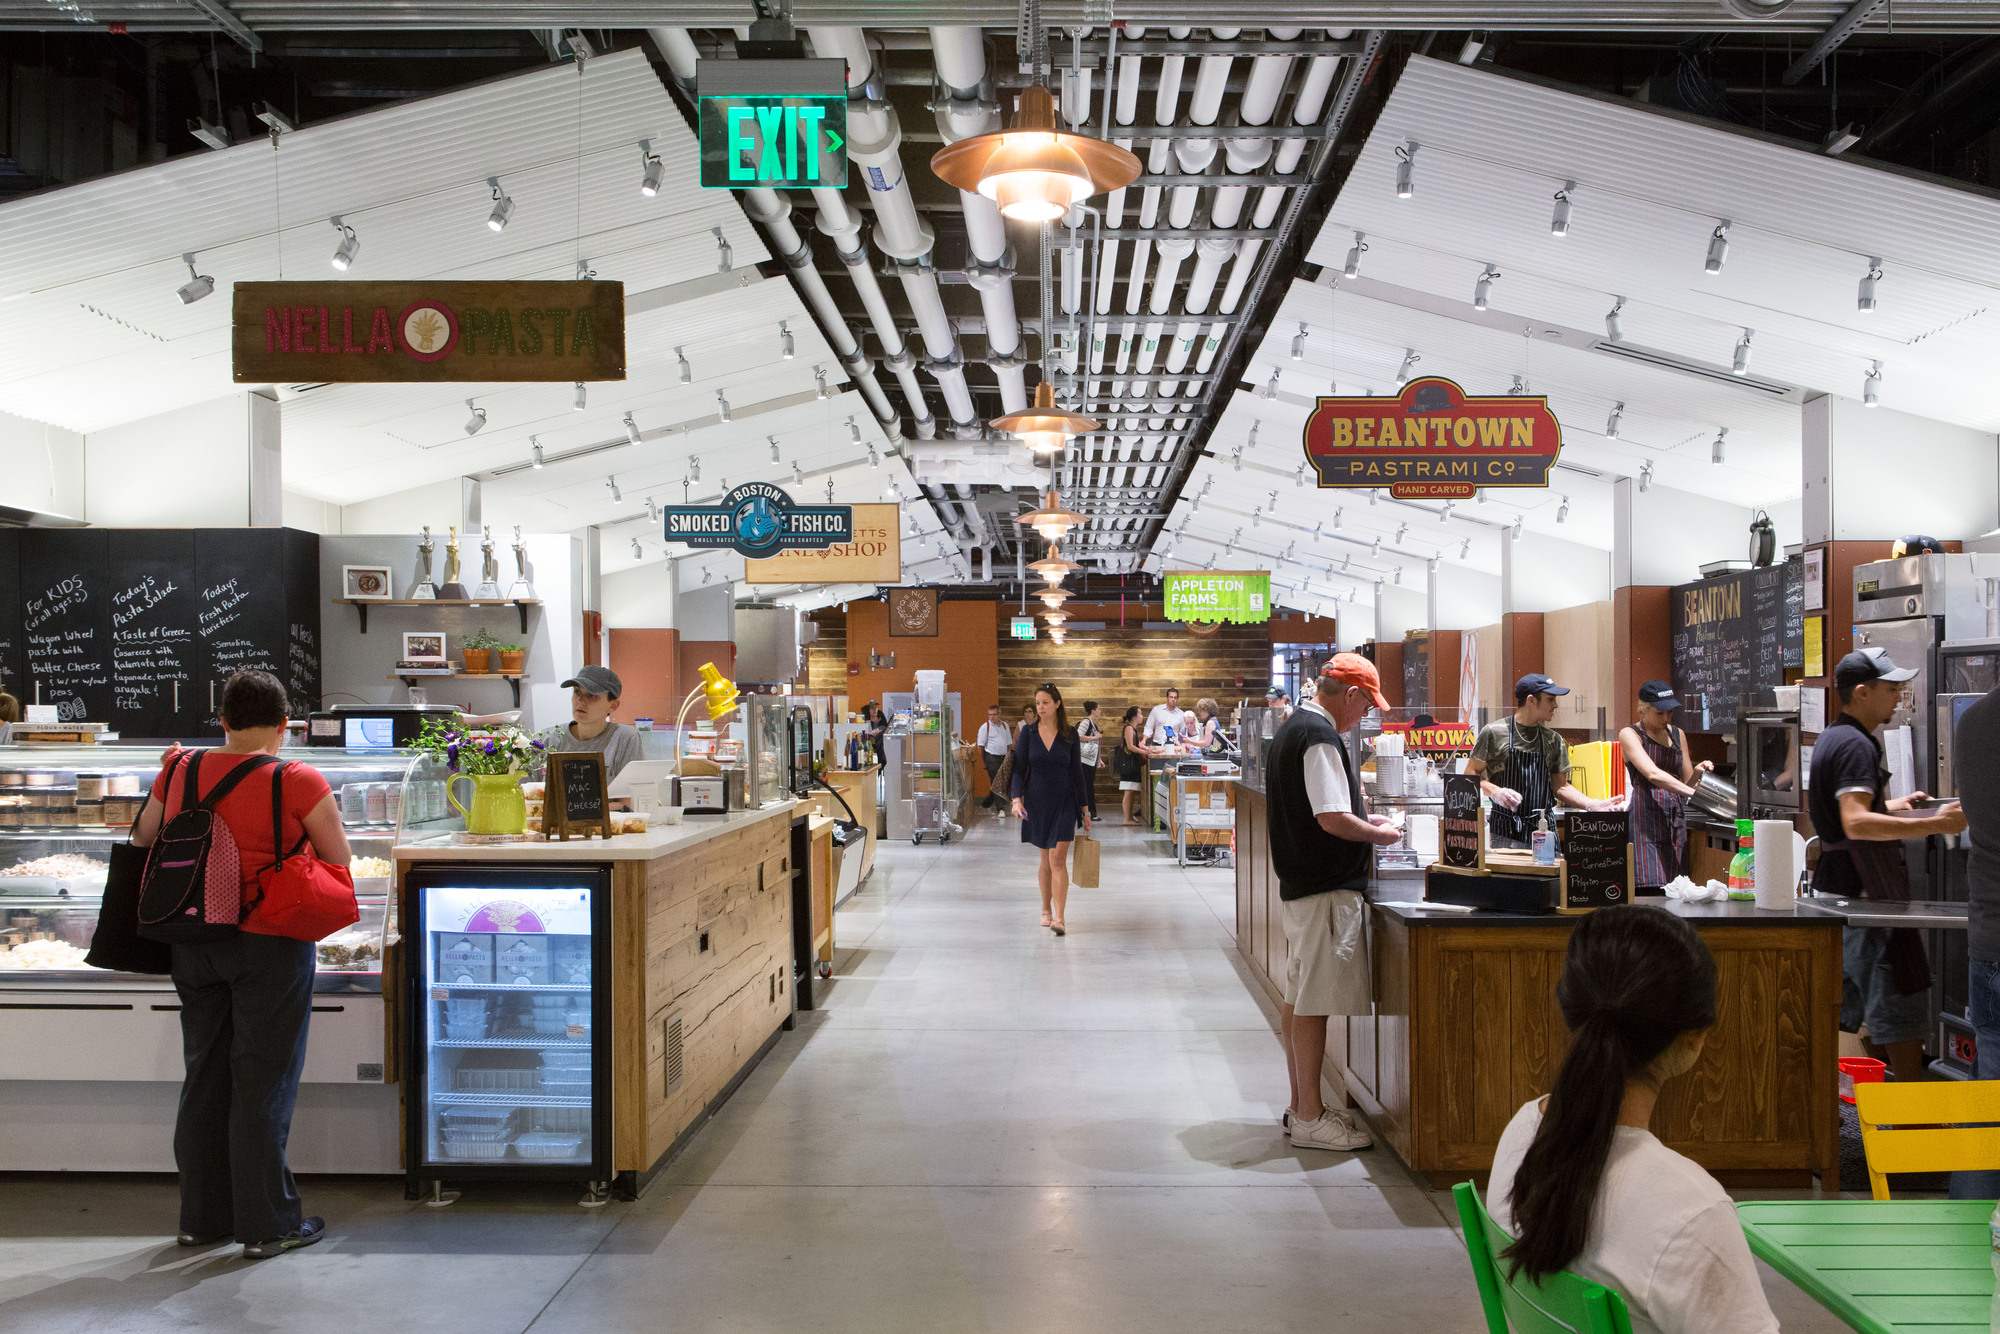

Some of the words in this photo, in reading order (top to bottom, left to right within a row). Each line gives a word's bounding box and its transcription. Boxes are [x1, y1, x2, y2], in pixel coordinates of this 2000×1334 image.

[728, 106, 825, 181] EXIT
[265, 306, 394, 354] NELLA
[462, 306, 597, 357] PASTA
[1331, 417, 1535, 448] BEANTOWN
[1350, 461, 1477, 476] PASTRAMI
[733, 484, 782, 502] BOSTON
[1397, 485, 1427, 495] HAND
[1430, 485, 1470, 495] CARVED
[670, 514, 730, 532] SMOKED
[791, 514, 822, 532] FISH
[824, 514, 847, 532] CO.
[833, 542, 887, 557] SHOP
[113, 575, 155, 606] Today's
[202, 577, 238, 601] Today's
[1171, 580, 1245, 592] APPLETON
[26, 598, 43, 615] For
[46, 574, 83, 601] KIDS
[1171, 593, 1219, 605] FARMS
[40, 608, 52, 621] all
[53, 596, 73, 614] ages
[113, 604, 145, 628] Pasta
[144, 581, 178, 608] Salad
[199, 606, 223, 624] Fresh
[221, 591, 250, 610] Pasta
[1684, 580, 1741, 627] BEANTOWN
[121, 627, 147, 640] Taste
[150, 626, 159, 637] of
[1015, 623, 1031, 636] EXIT
[29, 635, 60, 648] Wagon
[65, 628, 93, 640] Wheel
[28, 646, 60, 660] pasta
[62, 645, 84, 655] with
[155, 646, 173, 655] with
[247, 649, 271, 658] Grain
[67, 662, 101, 673] Cheese
[114, 657, 156, 670] Kalamata
[158, 657, 181, 667] olive
[216, 662, 237, 675] Spicy
[50, 689, 73, 700] peas
[114, 684, 152, 699] arugula
[115, 696, 142, 710] feta
[568, 782, 591, 794] MAC
[567, 798, 601, 812] CHEESE?
[1446, 790, 1477, 811] WELCOME
[1570, 816, 1625, 833] BEANTOWN
[1447, 834, 1477, 850] PASTRAMI
[1568, 841, 1603, 853] Pastrami
[1570, 874, 1599, 892] Pilgrim
